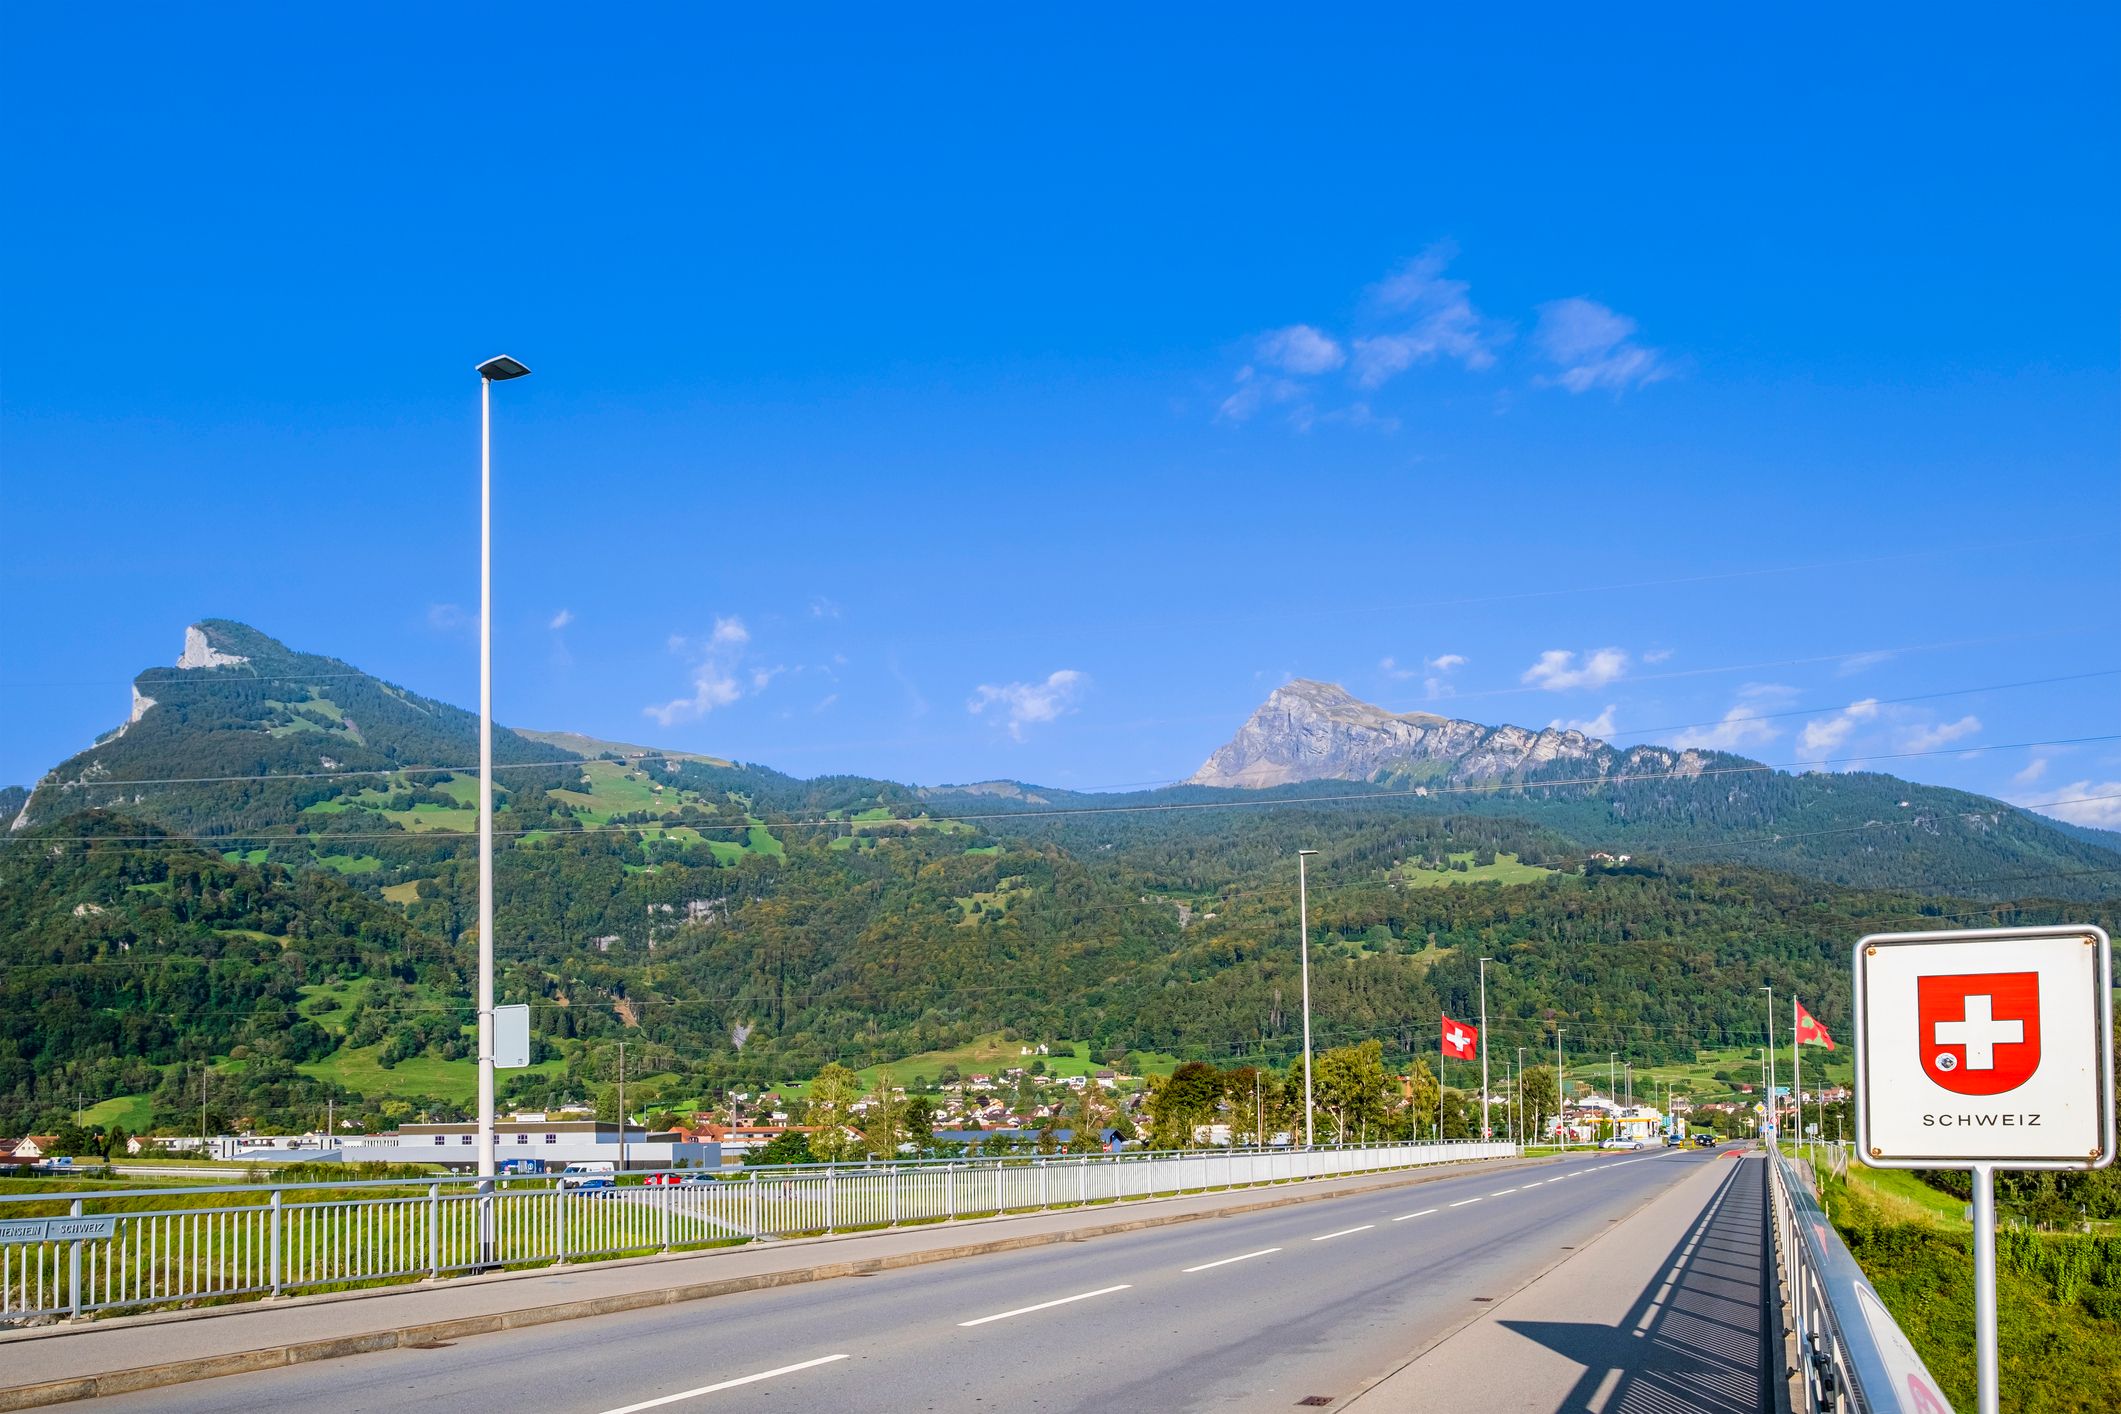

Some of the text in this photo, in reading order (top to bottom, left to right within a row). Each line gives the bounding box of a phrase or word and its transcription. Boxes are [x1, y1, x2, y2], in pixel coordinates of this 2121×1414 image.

[1922, 1114, 2041, 1126] SCHWEIZ
[0, 1223, 105, 1238] TENSTEIN SCHWEIZ
